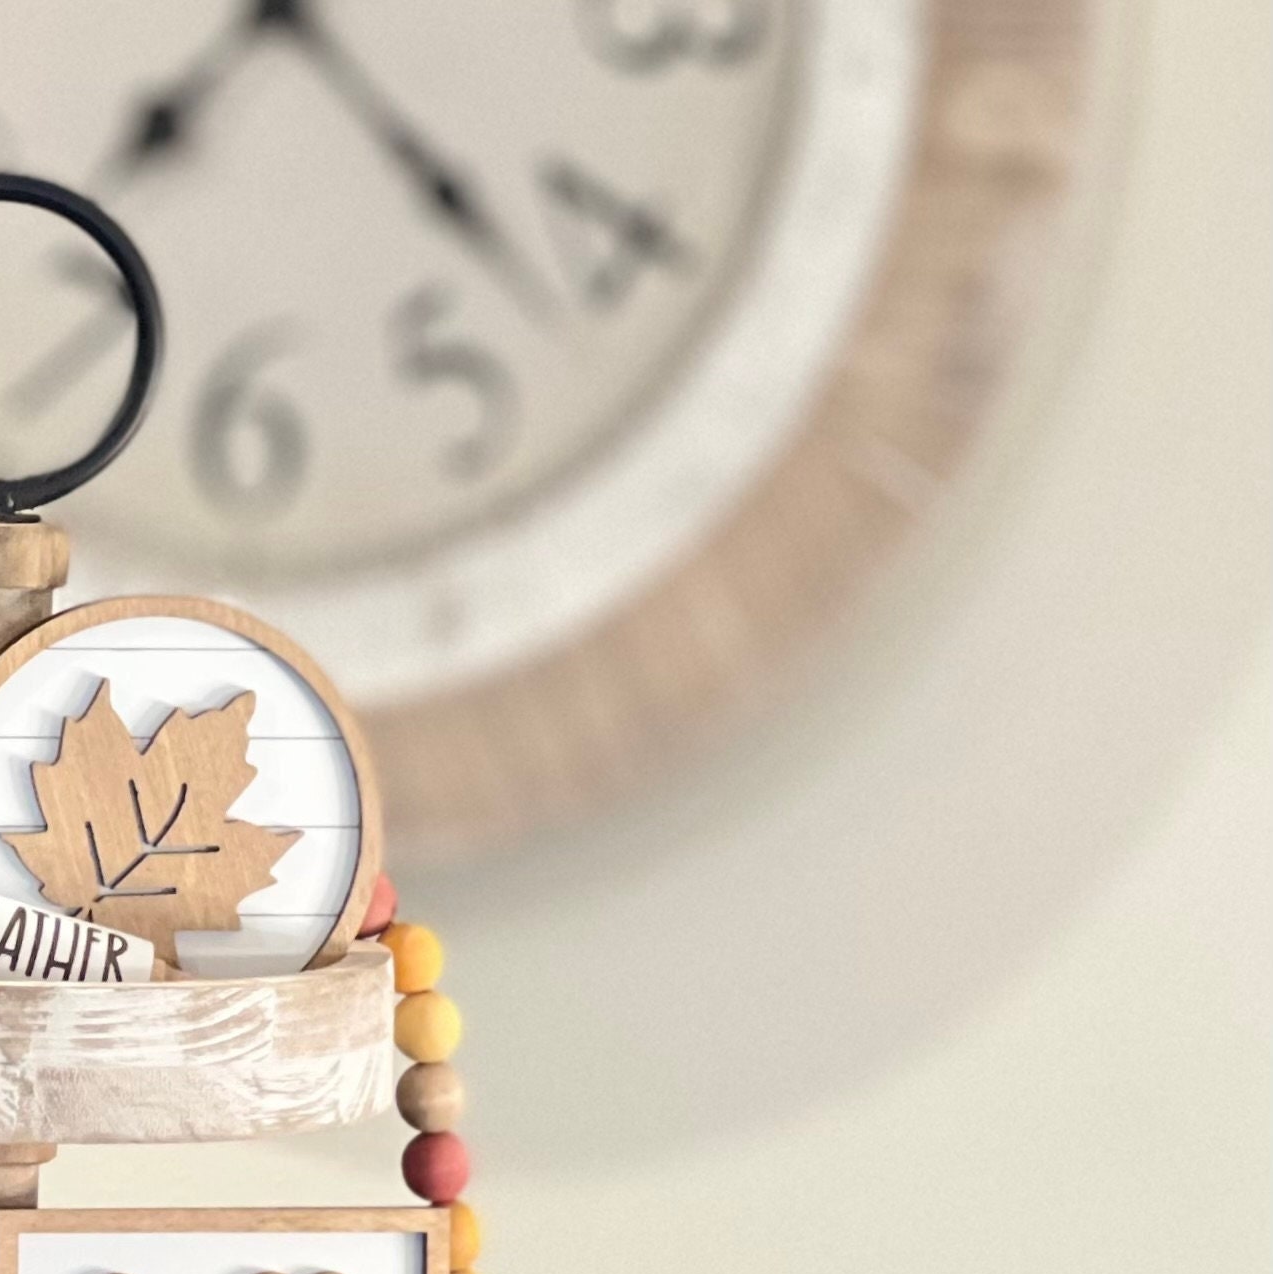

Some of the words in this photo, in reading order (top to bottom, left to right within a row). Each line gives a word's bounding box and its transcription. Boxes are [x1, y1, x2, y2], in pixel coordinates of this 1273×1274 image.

[534, 155, 703, 308] 4
[187, 316, 312, 522] 6
[386, 283, 521, 488] 5
